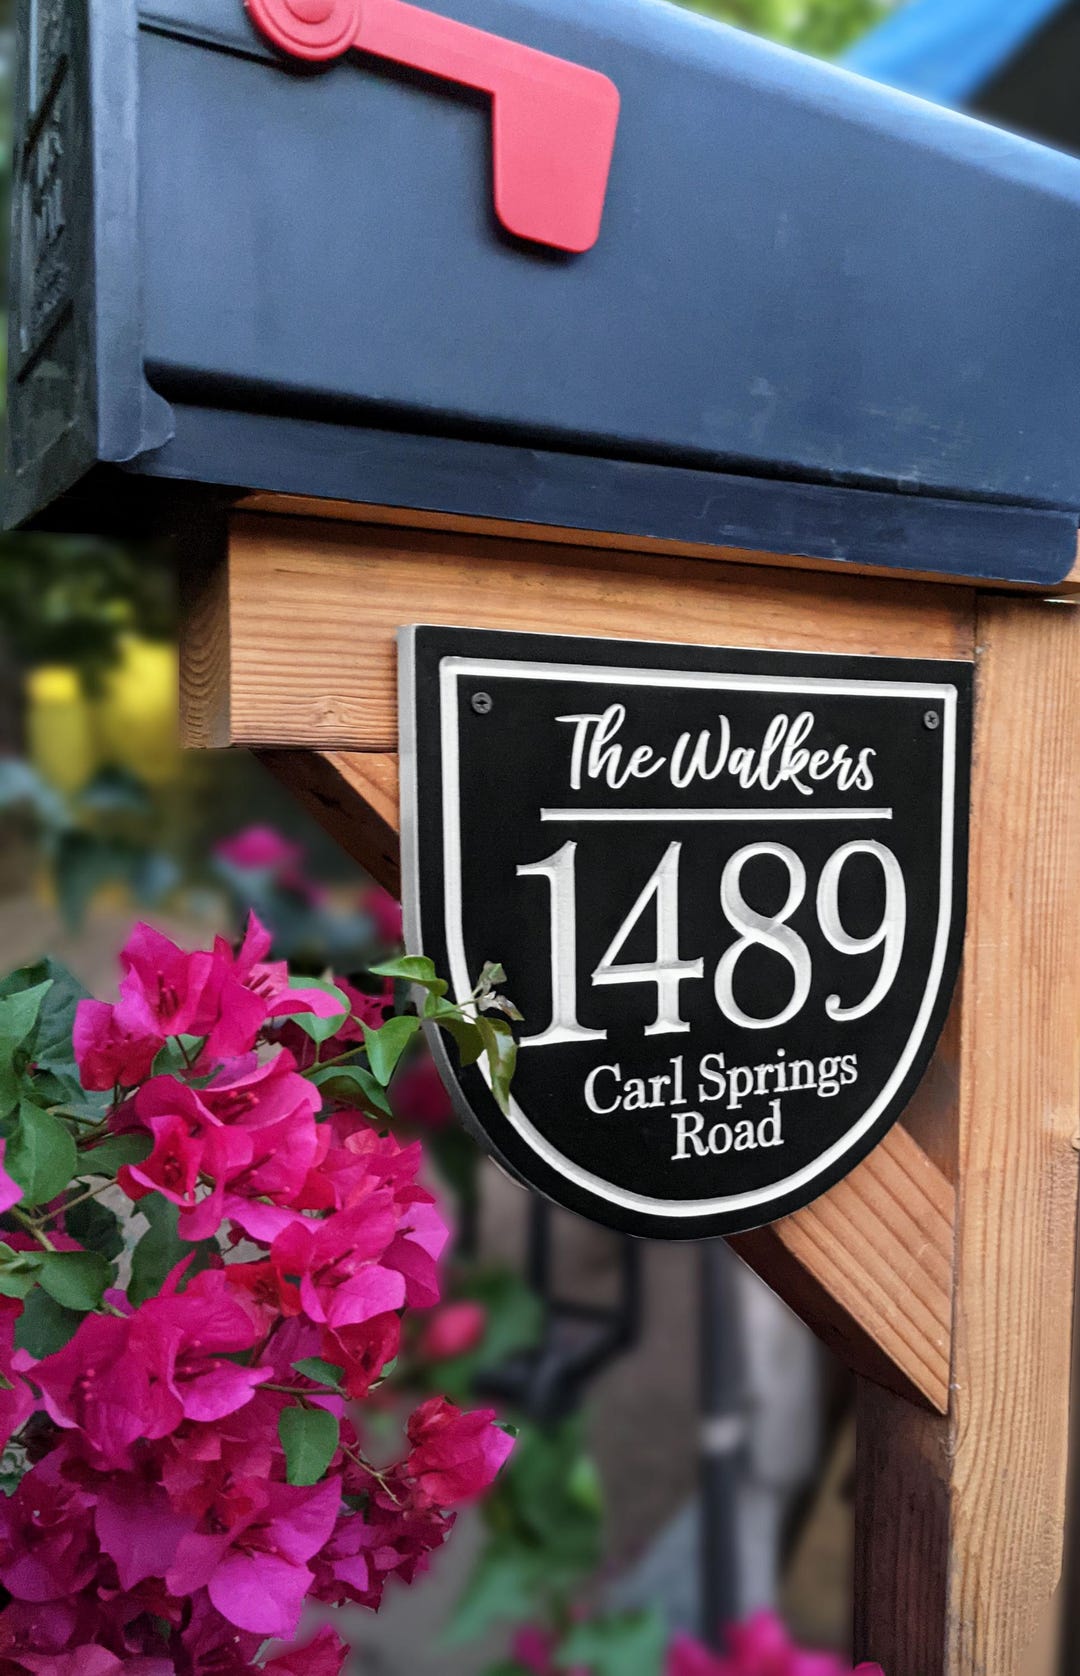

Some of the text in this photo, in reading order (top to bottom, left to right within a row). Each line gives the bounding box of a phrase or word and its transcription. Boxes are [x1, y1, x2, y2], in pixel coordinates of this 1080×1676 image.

[555, 703, 877, 796] The Walkers
[516, 839, 907, 1048] 1489
[583, 1048, 859, 1115] Carl Springs
[670, 1098, 785, 1161] Road
